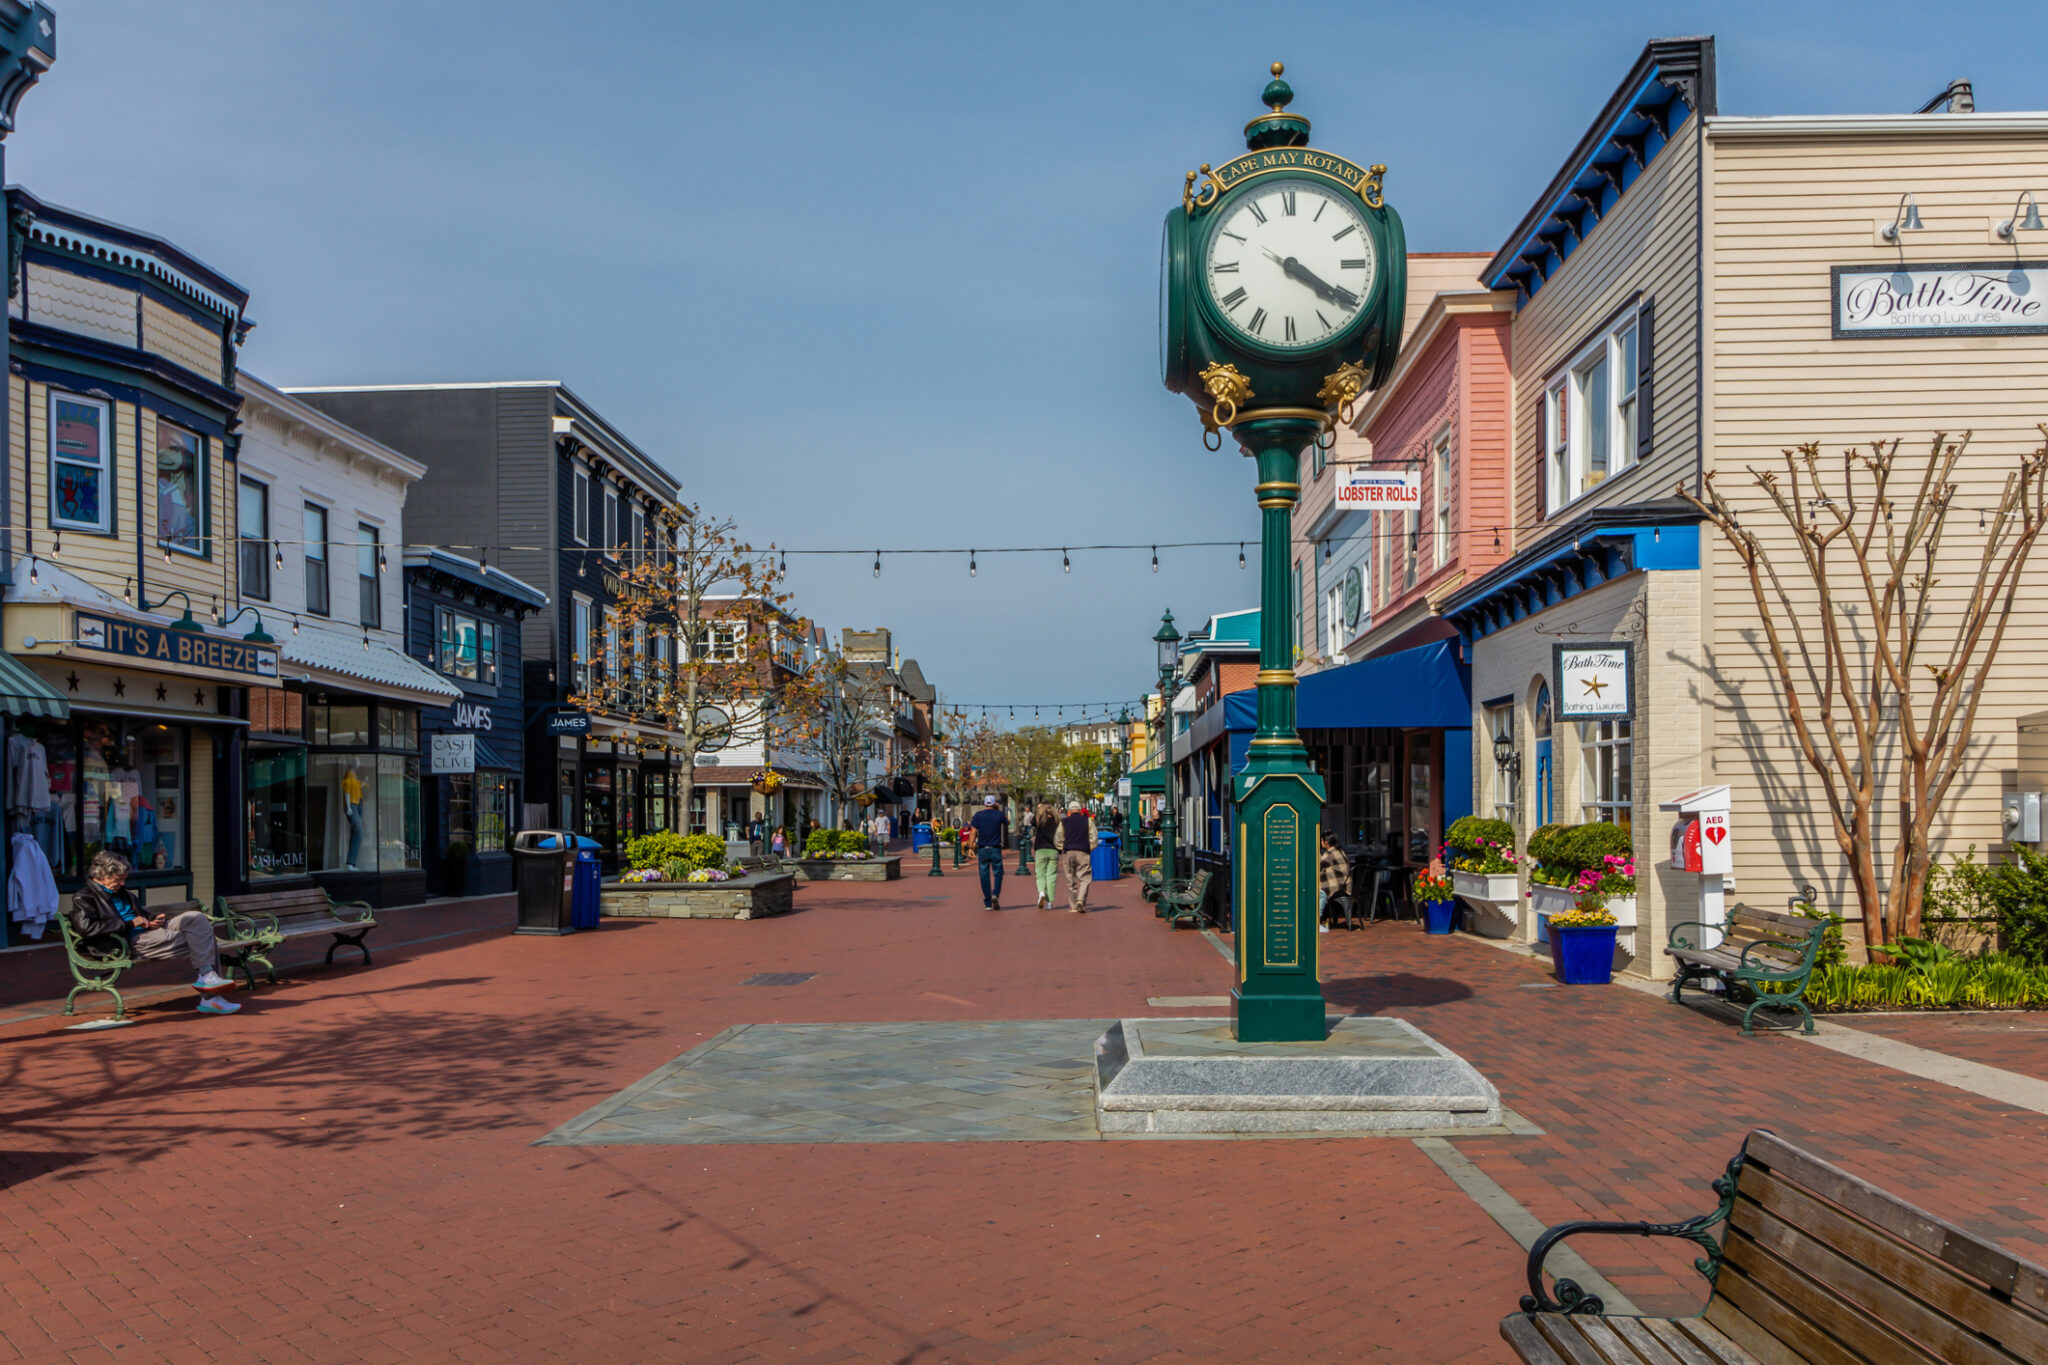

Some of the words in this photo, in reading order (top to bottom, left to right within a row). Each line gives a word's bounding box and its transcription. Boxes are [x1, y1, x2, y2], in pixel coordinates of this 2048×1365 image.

[1218, 158, 1259, 183] CAPE
[1262, 152, 1299, 167] MAY
[1303, 153, 1364, 184] ROTARY
[1846, 276, 1950, 323] Bath
[1946, 271, 2041, 317] Time
[1890, 311, 1941, 326] Bathing
[1944, 310, 2001, 324] Luxuries
[1339, 487, 1383, 501] LOBSTER
[1387, 487, 1418, 501] ROLLS
[107, 623, 149, 656] IT'S
[156, 633, 171, 659] A
[178, 637, 257, 672] BREEZE
[1563, 655, 1594, 671] Bath
[1594, 653, 1624, 669] Time
[1564, 702, 1593, 713] Bathing
[1596, 702, 1626, 711] Luxuries
[453, 702, 492, 730] JAMES
[551, 718, 586, 727] JAMES
[433, 739, 473, 751] CASH
[433, 756, 472, 769] CLIVE
[1706, 816, 1723, 825] AED
[251, 854, 275, 869] CASH
[282, 851, 304, 866] CLIVE
